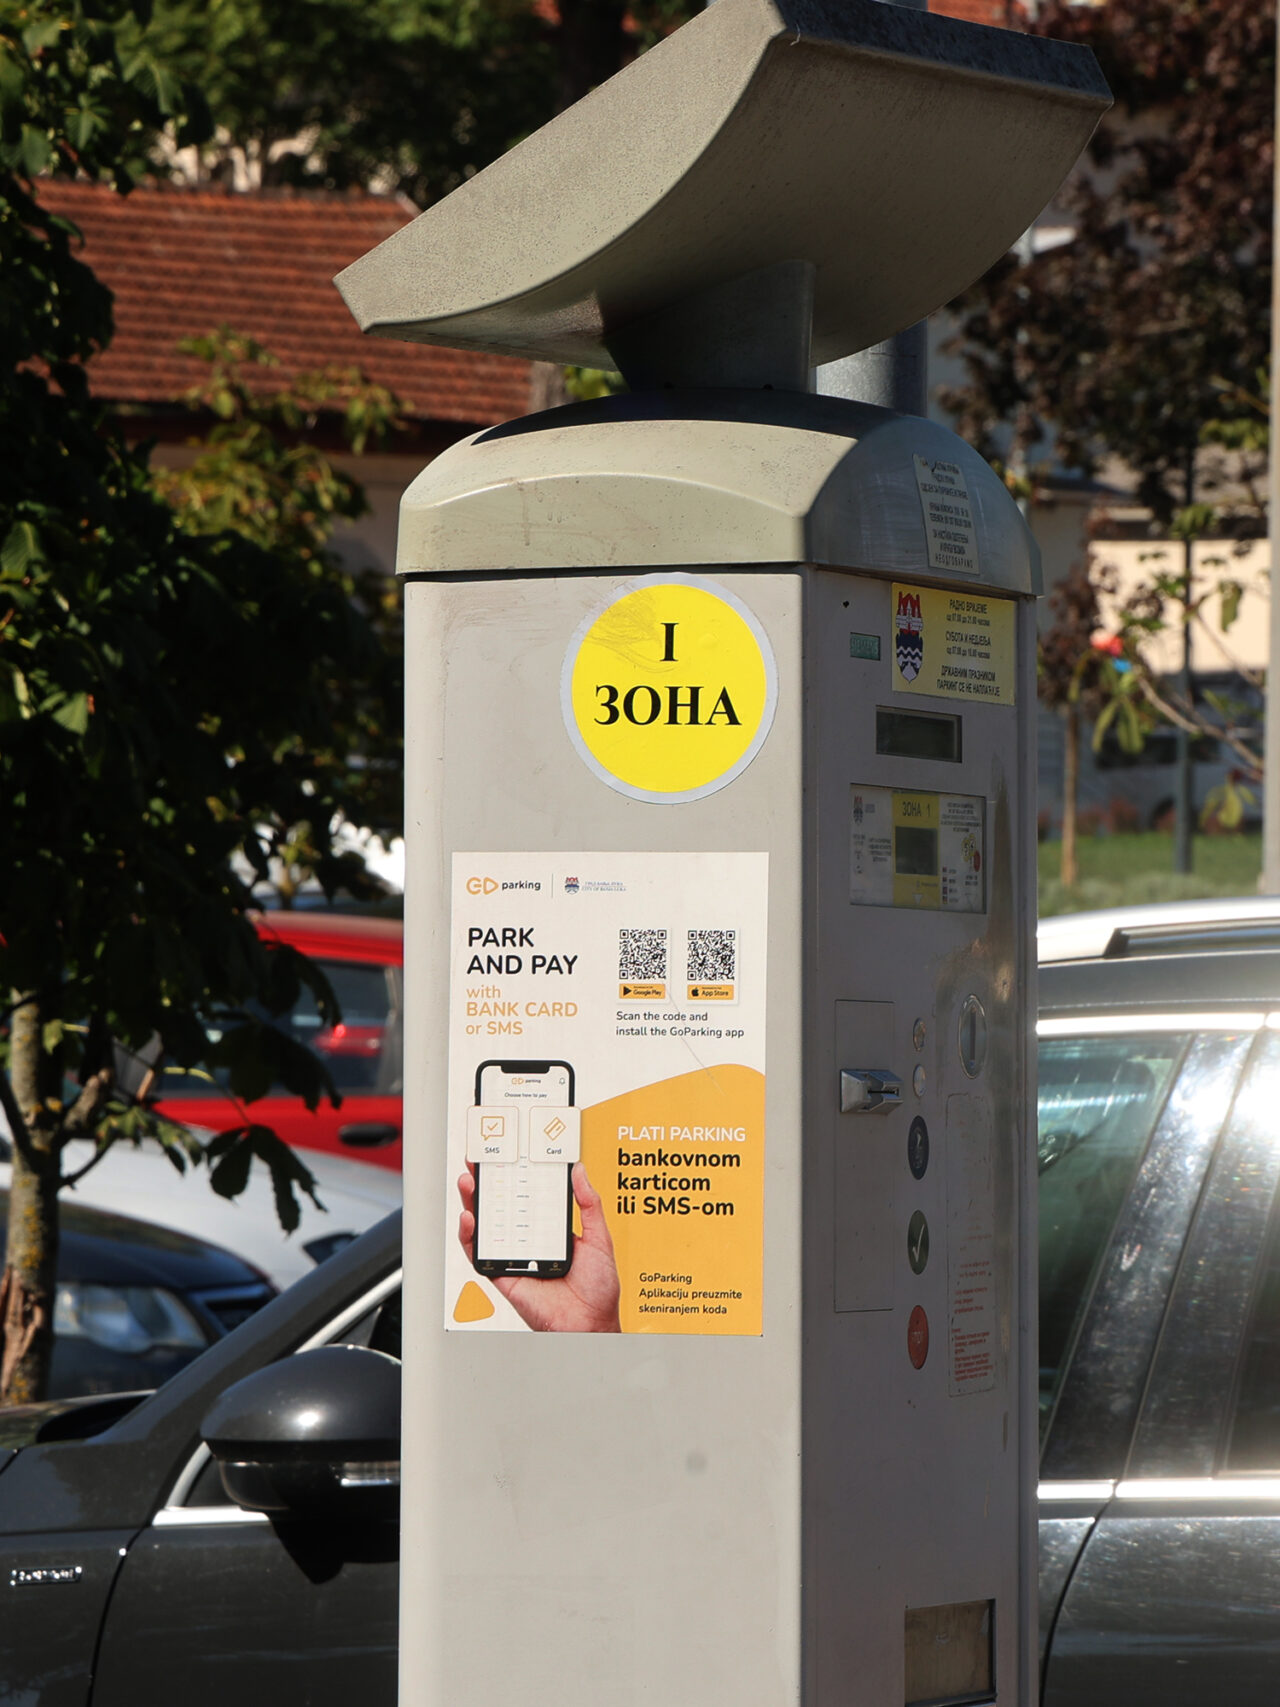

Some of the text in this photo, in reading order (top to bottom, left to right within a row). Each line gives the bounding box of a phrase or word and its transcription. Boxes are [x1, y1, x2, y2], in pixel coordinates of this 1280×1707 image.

[593, 684, 743, 726] ЗОНА
[902, 801, 922, 817] ЗОНА
[502, 880, 541, 892] parking
[468, 927, 535, 948] PARK
[467, 955, 578, 976] AND PAY
[467, 985, 501, 999] with
[466, 1002, 578, 1017] BANK CARD
[616, 1011, 708, 1022] Scan the code and
[466, 1021, 523, 1036] or SMS
[616, 1026, 745, 1039] install the GoParking app
[617, 1126, 747, 1142] PLATI PARKING
[546, 1147, 562, 1155] Card
[617, 1148, 741, 1168] bankovnom
[617, 1172, 711, 1191] karticom
[617, 1197, 735, 1216] ili SMS-om
[639, 1273, 692, 1285] GoParking
[639, 1288, 742, 1301] Aplikaciju preuzmite
[639, 1304, 727, 1316] skeniranjem koda
